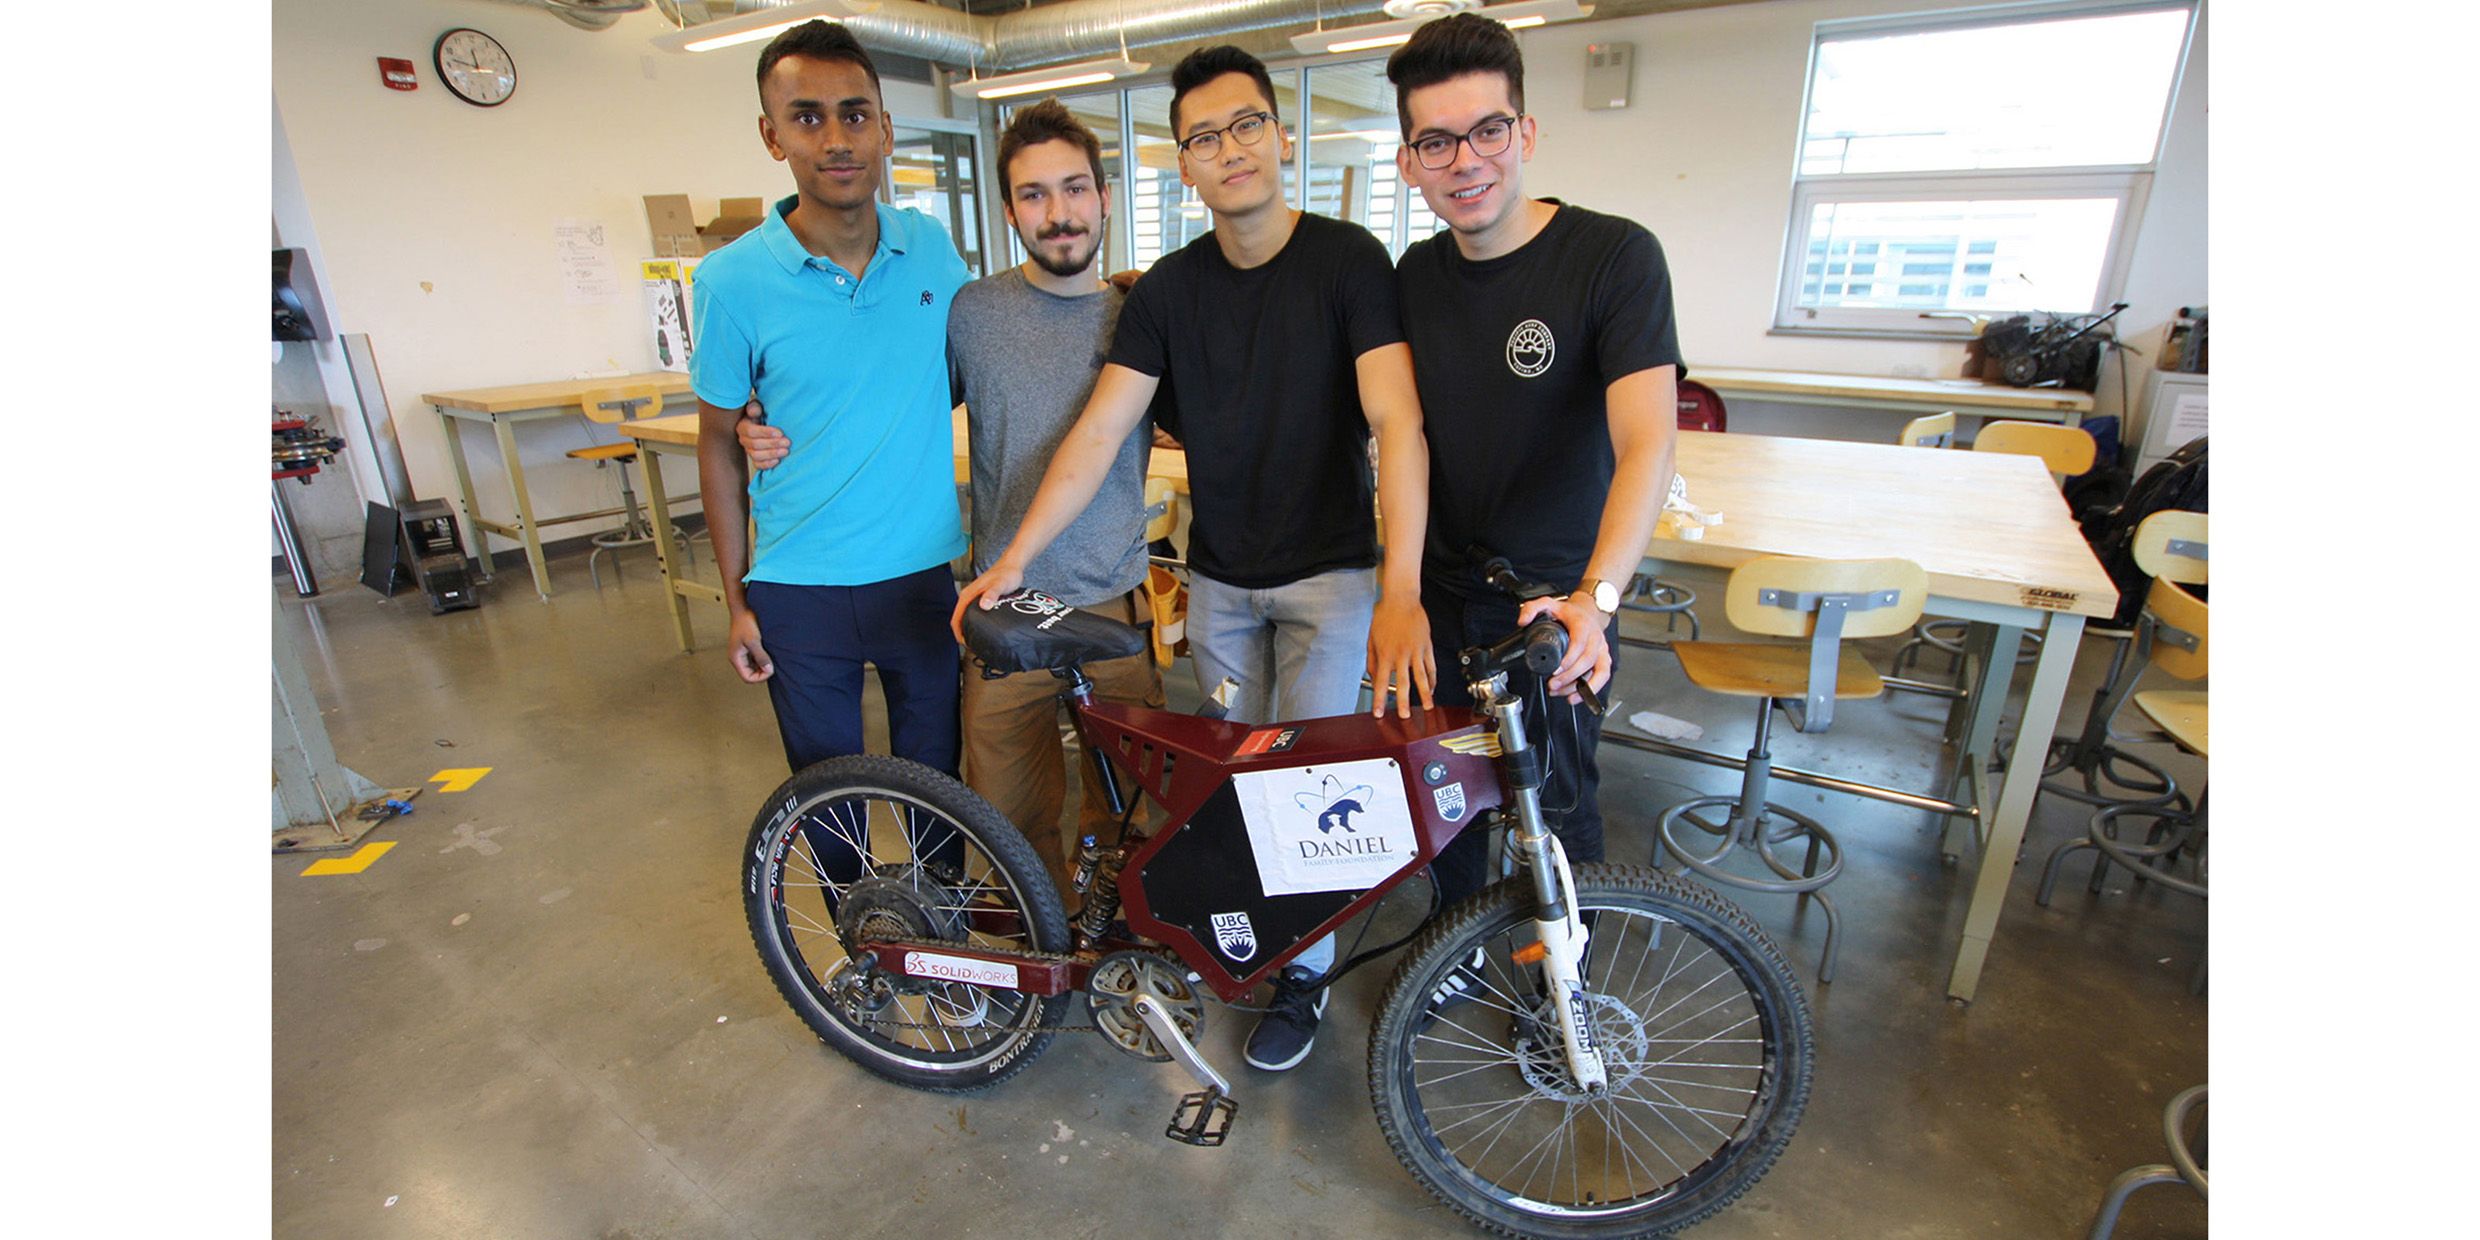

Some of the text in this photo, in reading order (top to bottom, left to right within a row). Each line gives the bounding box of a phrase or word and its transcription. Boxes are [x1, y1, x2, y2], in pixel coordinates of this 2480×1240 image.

[1435, 784, 1461, 799] UBC
[1298, 836, 1393, 859] DANIEL
[1303, 853, 1394, 867] FAMILY FOUNDATION
[1213, 913, 1249, 928] UBC
[931, 964, 1017, 984] SOLIDWORKS
[1570, 1000, 1592, 1052] ZOOM
